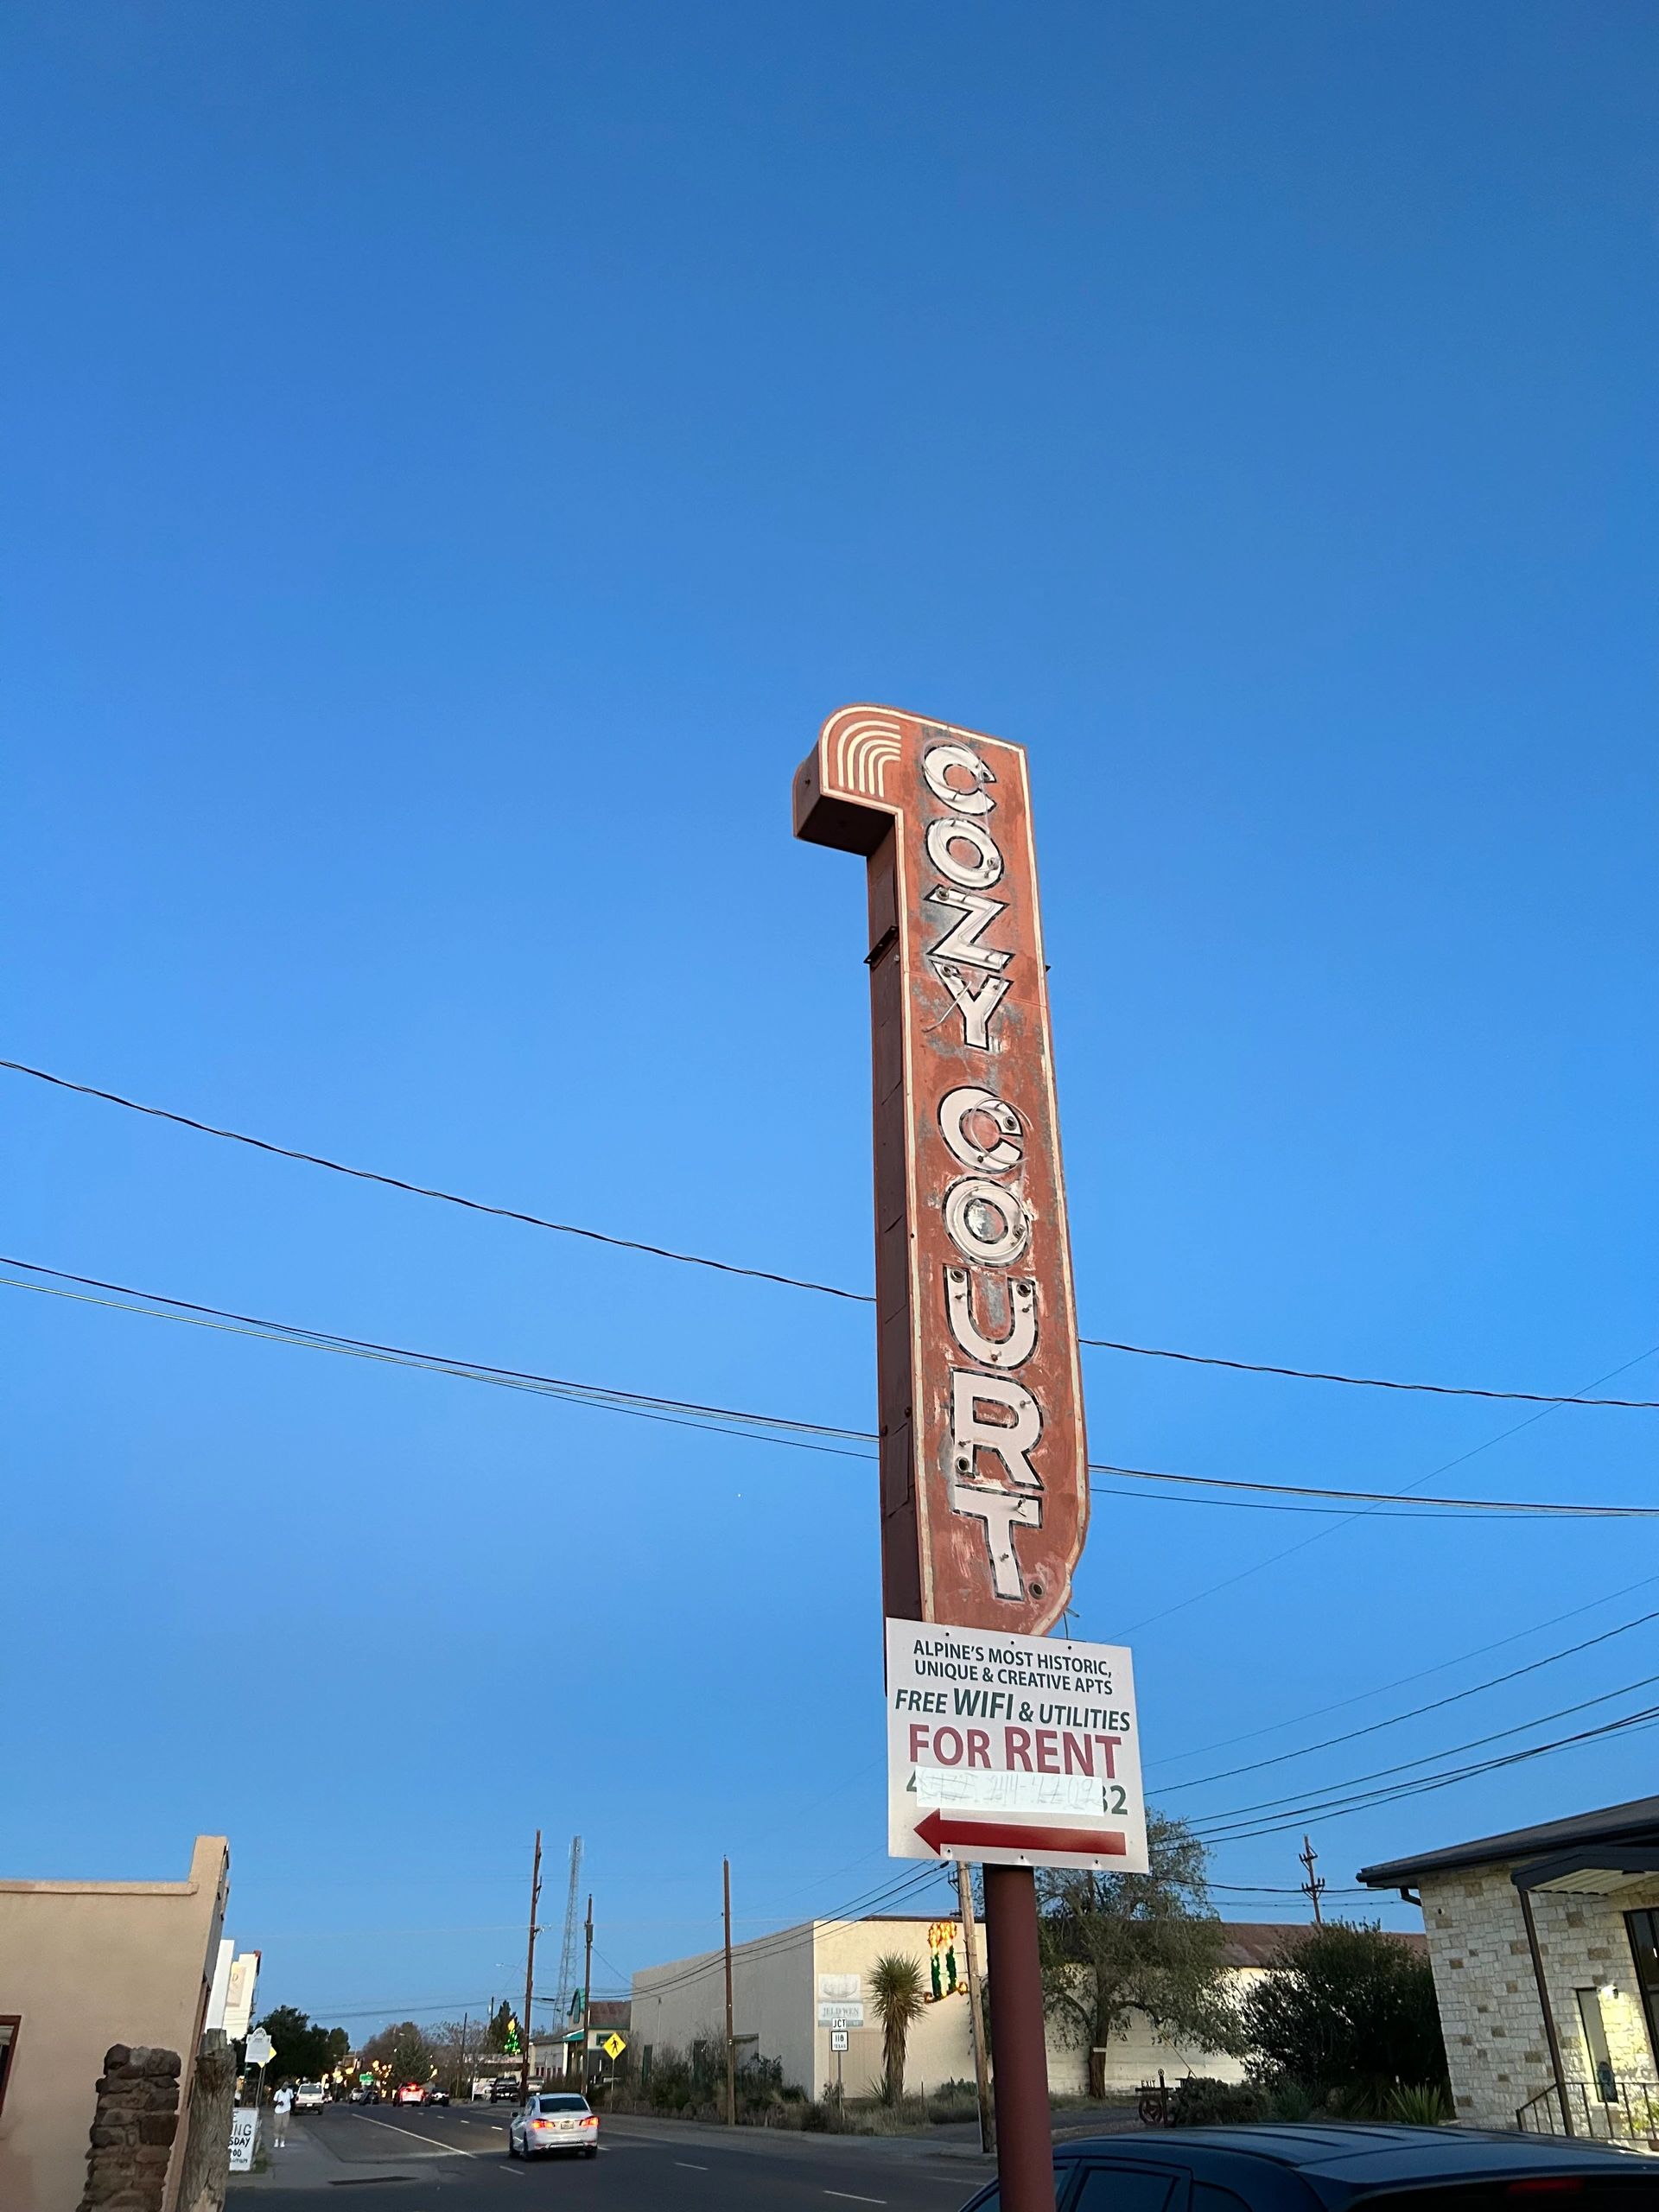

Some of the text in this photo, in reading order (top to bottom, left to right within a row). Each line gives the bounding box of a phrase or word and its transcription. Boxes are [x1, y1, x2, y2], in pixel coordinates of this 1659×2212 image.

[922, 745, 1044, 1601] COZY COURT
[913, 1639, 1111, 1678] ALPINE'S MOST HISTORIC,
[915, 1660, 1113, 1694] UNIQUE & CREATIVE APTS
[895, 1688, 1130, 1732] FREE WIFI & UTILITIES
[909, 1724, 1122, 1779] FOR RENT
[833, 2018, 846, 2028] JCT
[1141, 2080, 1155, 2088] EXIT
